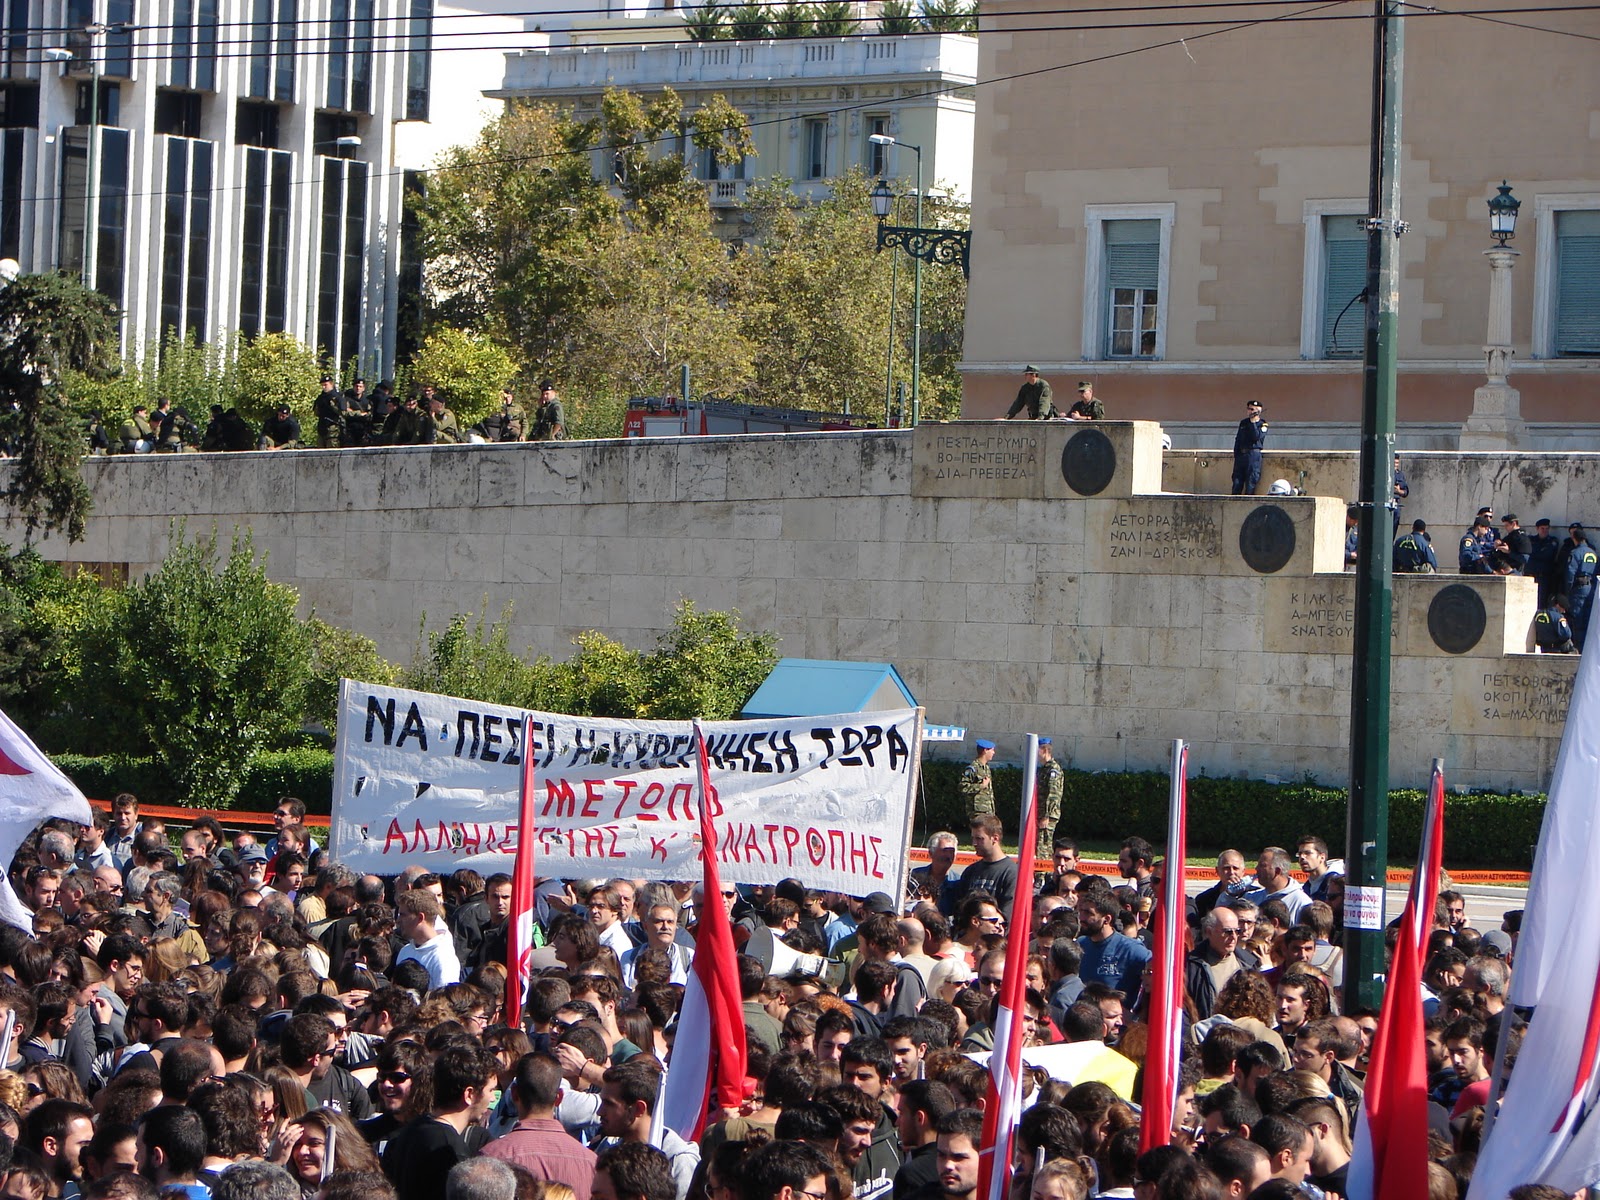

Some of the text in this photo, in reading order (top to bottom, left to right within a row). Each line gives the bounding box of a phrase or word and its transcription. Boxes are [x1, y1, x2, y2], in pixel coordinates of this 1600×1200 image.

[365, 696, 427, 751] ΝΑ
[455, 710, 554, 768] ΠΕΣΕΙ
[566, 728, 596, 768] Η
[810, 724, 909, 773] ΤΩΡΑ
[541, 778, 724, 821] ΜΕΤΩΠΟ
[382, 817, 626, 858] ΑΛΛΗΛΕΓΥΗΣ
